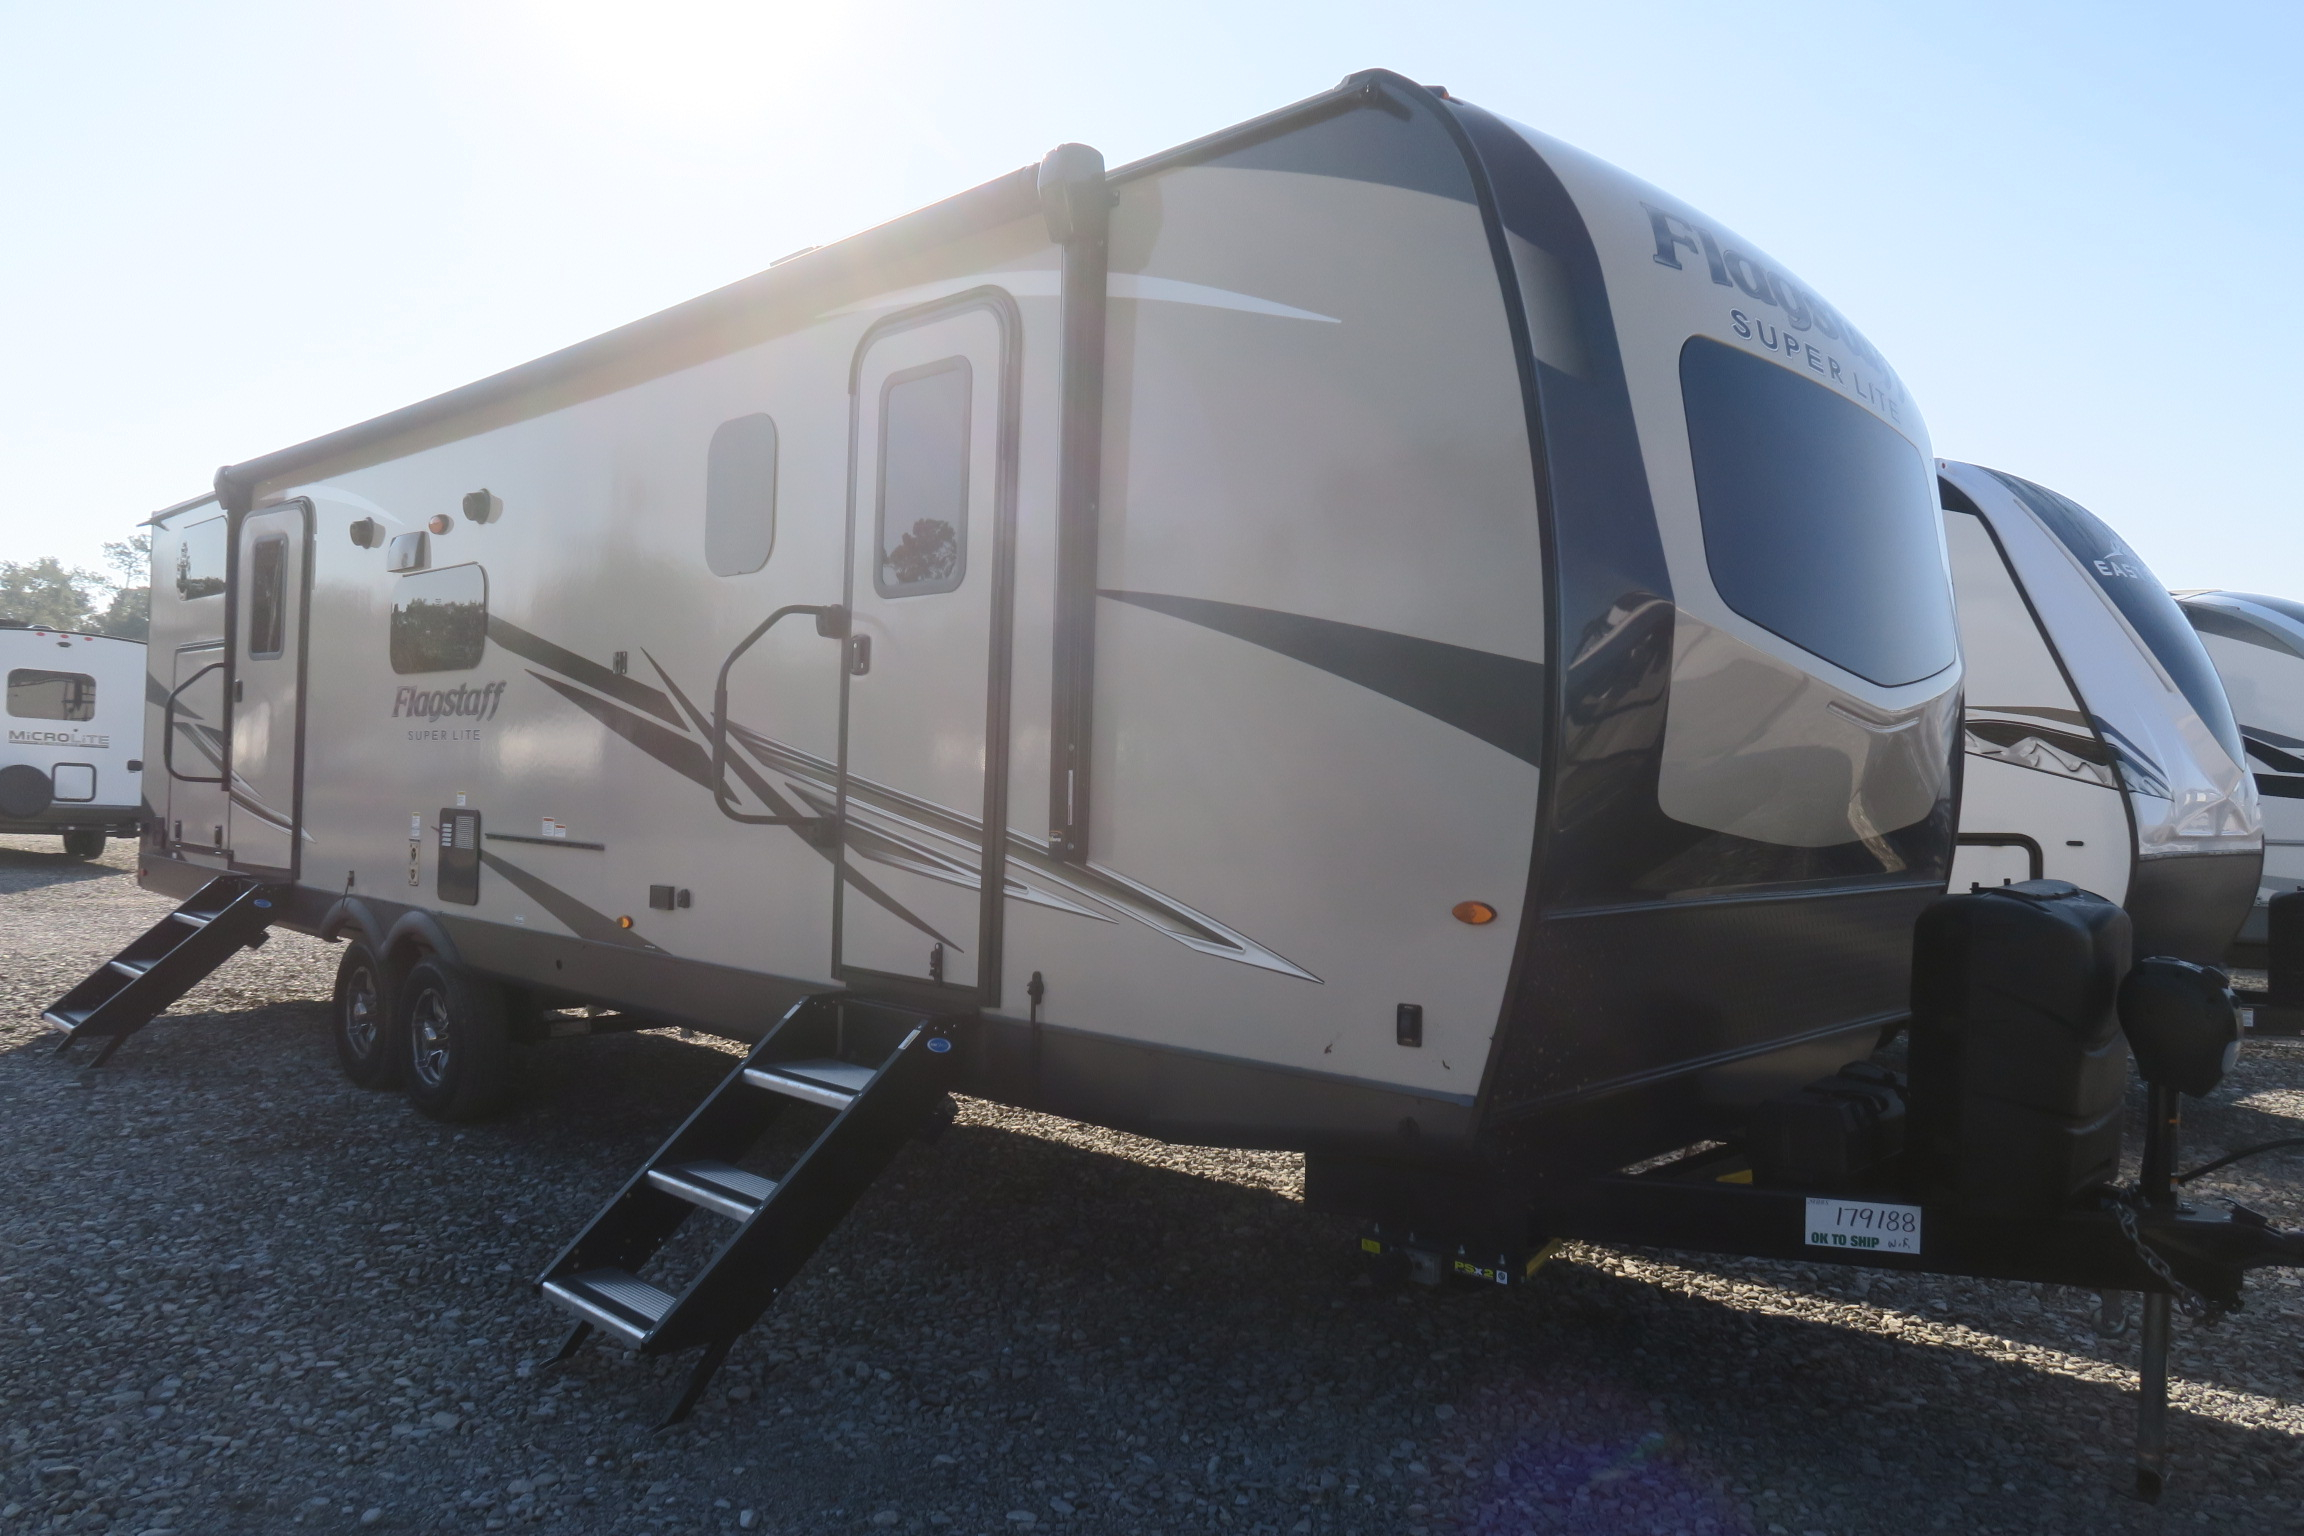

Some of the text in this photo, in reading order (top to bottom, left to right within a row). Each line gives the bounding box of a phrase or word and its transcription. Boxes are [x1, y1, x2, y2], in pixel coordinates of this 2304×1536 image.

[1730, 308, 1901, 424] SUPER LITE
[391, 680, 507, 722] Flagstaff
[408, 729, 481, 741] SUPER LITE
[1836, 1206, 1916, 1233] 179188
[1811, 1231, 1880, 1248] OK TO SHIP
